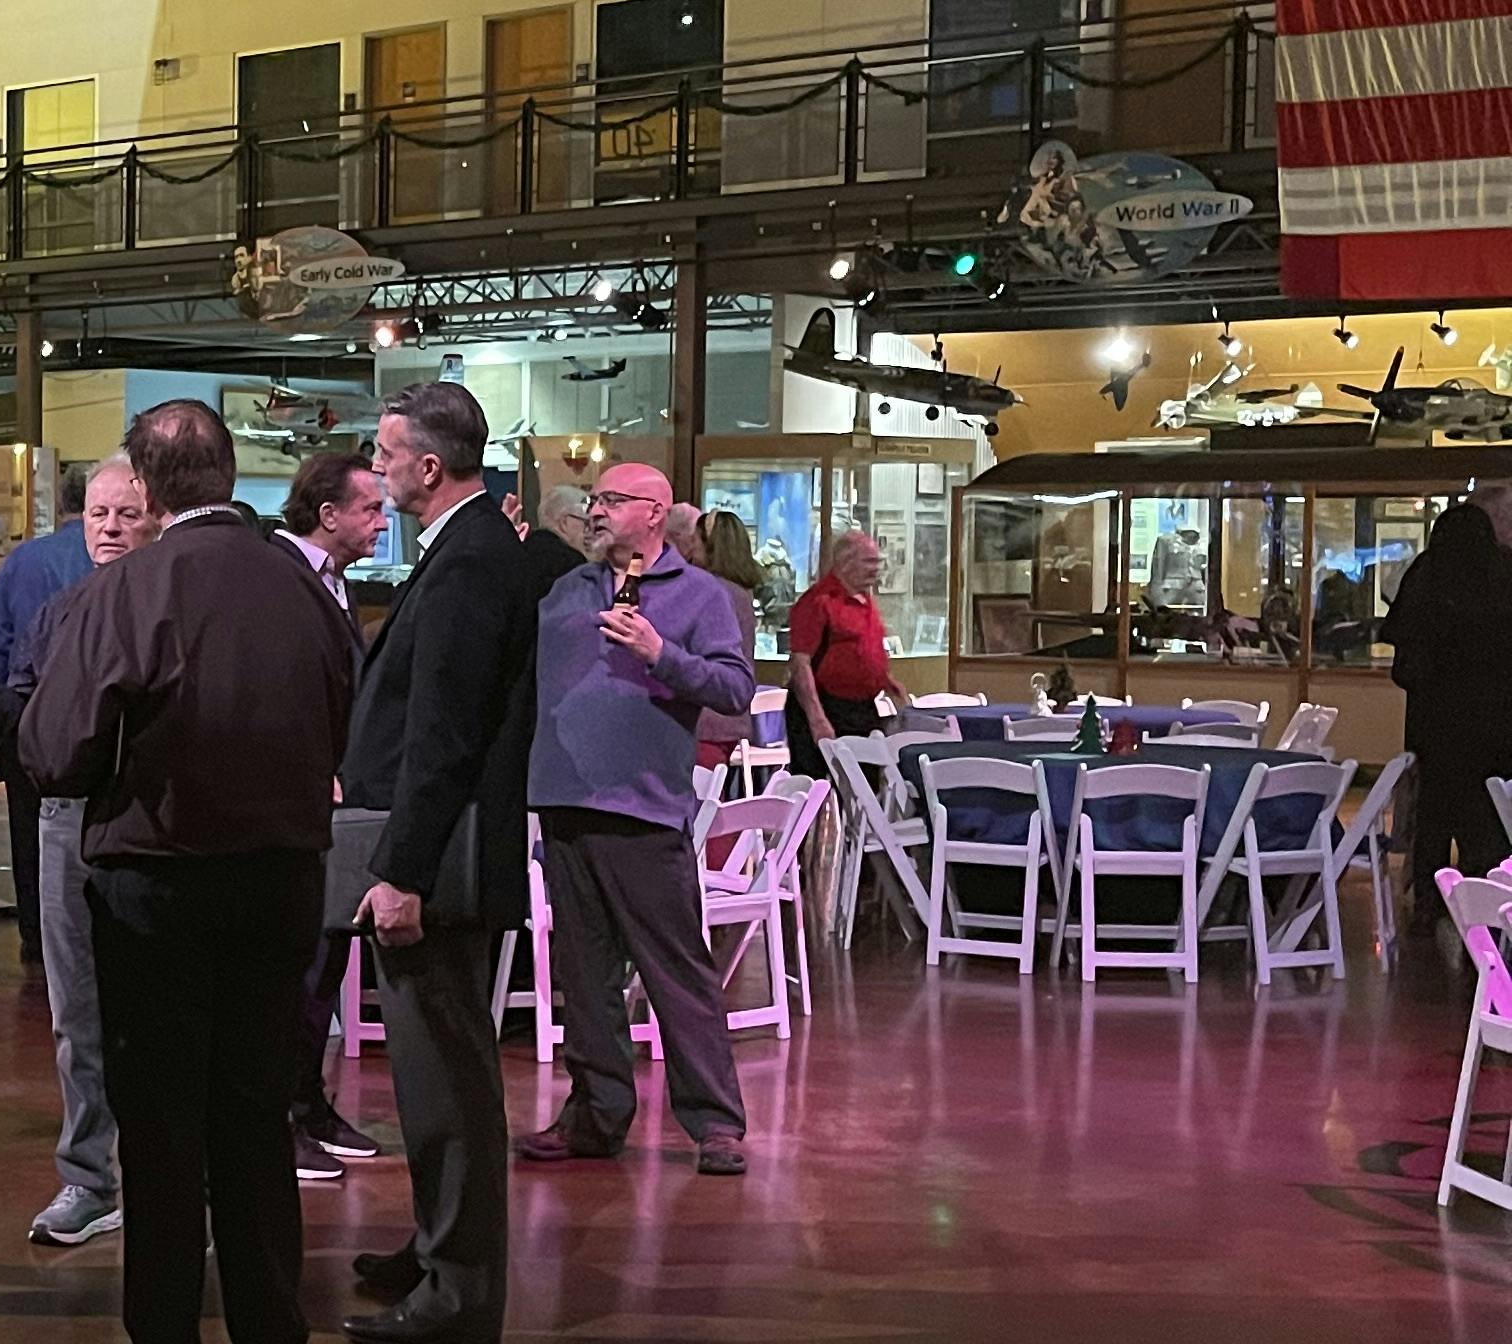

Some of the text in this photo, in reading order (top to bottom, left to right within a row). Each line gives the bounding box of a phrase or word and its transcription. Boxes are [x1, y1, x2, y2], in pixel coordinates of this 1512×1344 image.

[1116, 198, 1239, 222] World War II
[301, 262, 395, 284] Early Cold War
